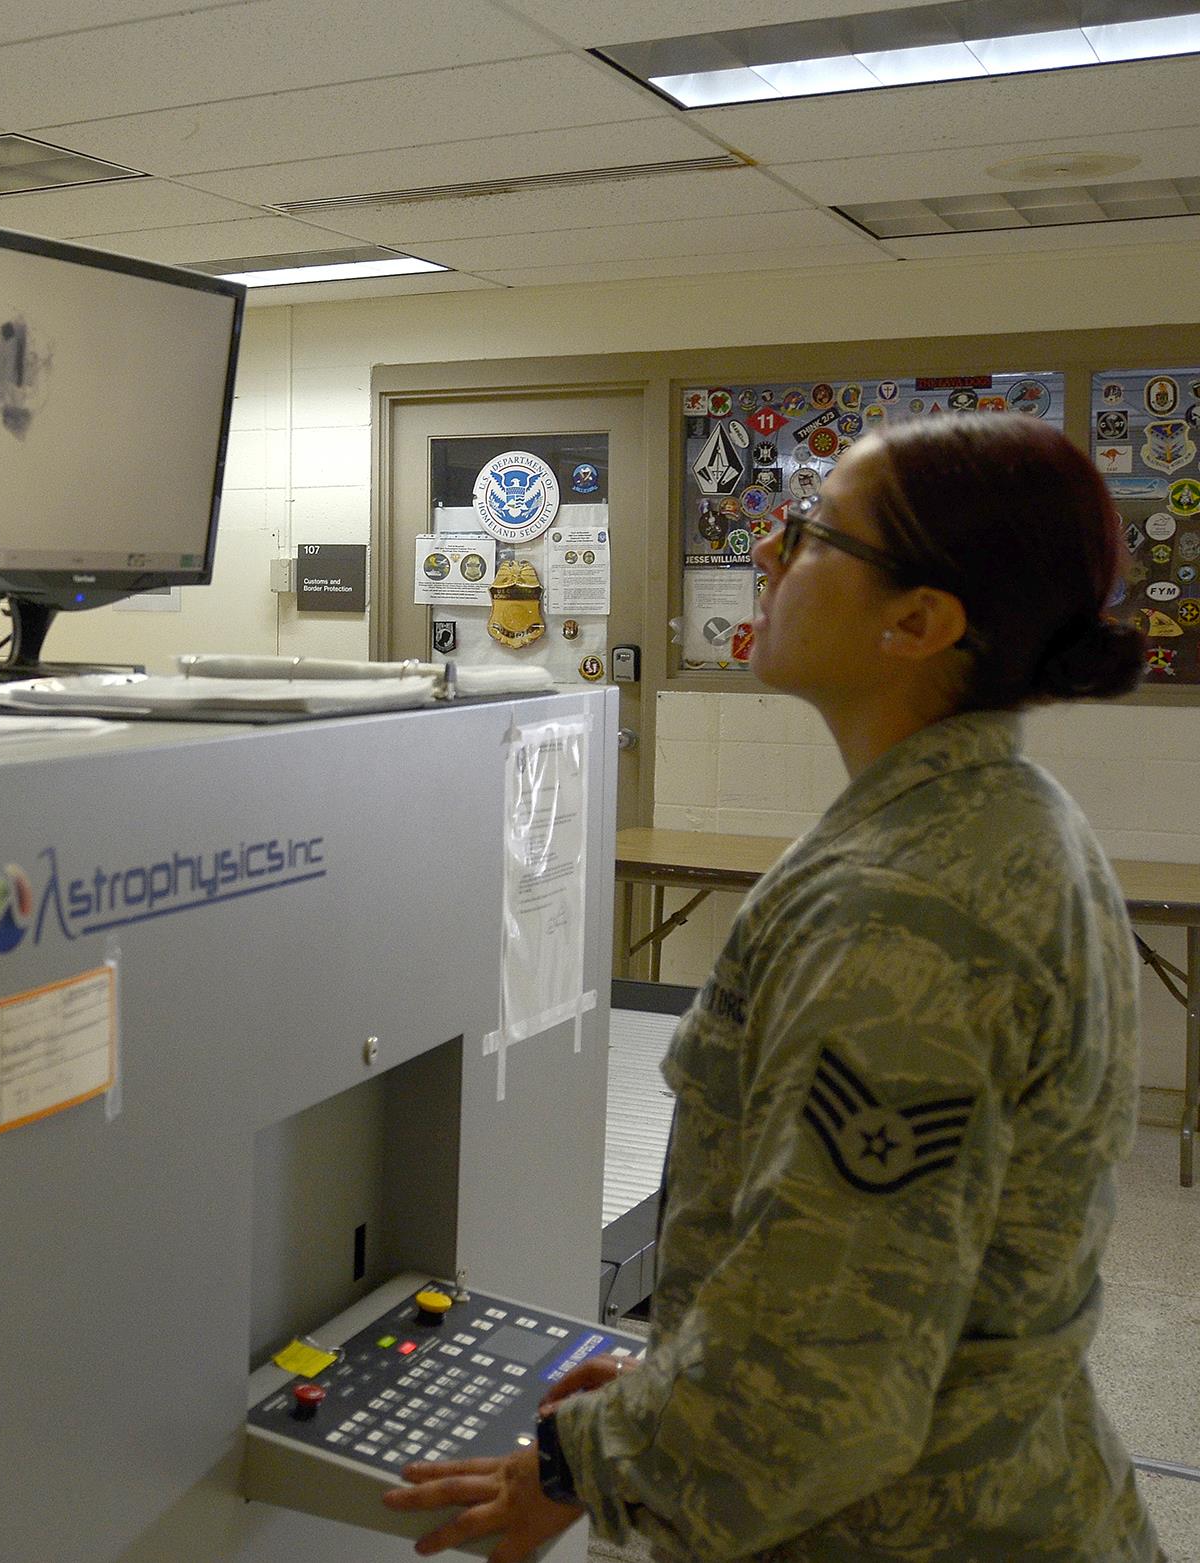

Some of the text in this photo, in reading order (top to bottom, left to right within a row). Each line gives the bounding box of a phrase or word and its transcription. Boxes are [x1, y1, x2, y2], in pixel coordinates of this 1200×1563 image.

[757, 414, 774, 429] 11
[798, 411, 835, 439] THINK 2/3
[491, 456, 548, 479] DEPARTMENT
[545, 479, 555, 491] OF
[478, 501, 553, 538] HOMELAND SECURITY
[304, 545, 320, 555] 107
[685, 555, 751, 564] JESSE WILLIAMS
